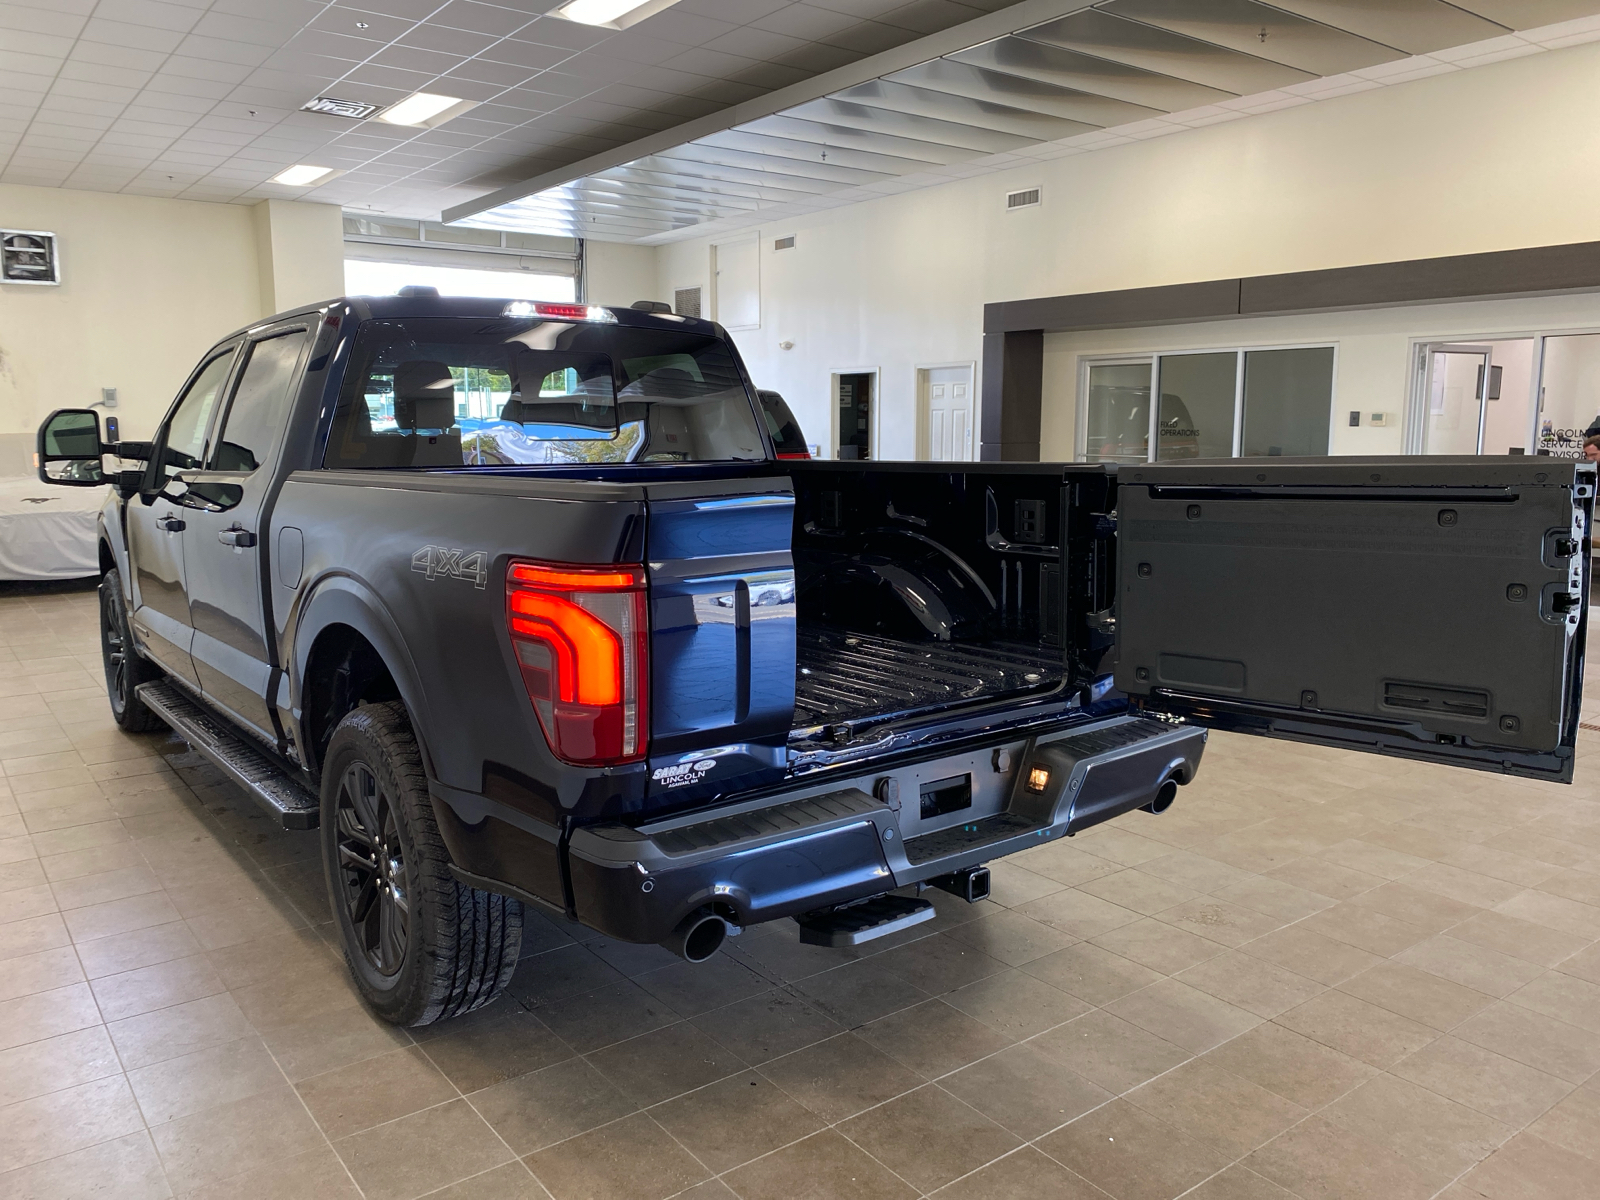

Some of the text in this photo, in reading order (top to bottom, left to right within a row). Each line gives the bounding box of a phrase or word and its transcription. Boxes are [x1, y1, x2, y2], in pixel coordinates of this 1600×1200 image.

[1160, 429, 1199, 437] OPERATIONS
[1541, 429, 1587, 437] LINCOLN
[1540, 440, 1583, 448] SERVICE
[1548, 451, 1588, 459] DVISOR
[411, 545, 487, 590] 4X4
[661, 771, 706, 785] LINCOLN
